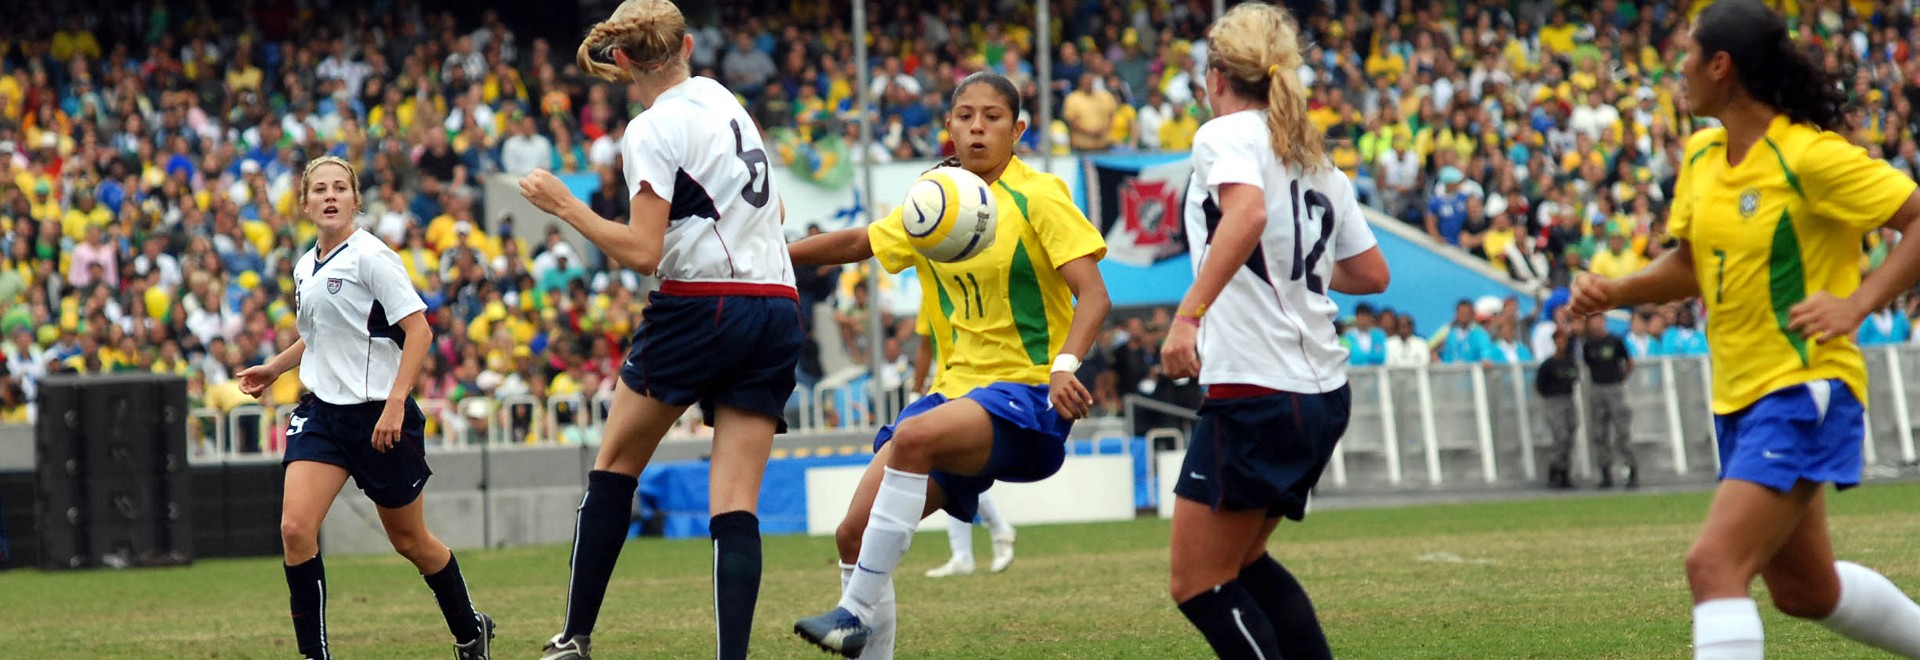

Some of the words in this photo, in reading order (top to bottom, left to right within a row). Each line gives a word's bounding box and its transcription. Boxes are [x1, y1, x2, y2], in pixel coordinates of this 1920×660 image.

[730, 118, 769, 209] 6
[1290, 179, 1335, 295] 12
[953, 272, 984, 320] 11
[1713, 247, 1726, 304] 7
